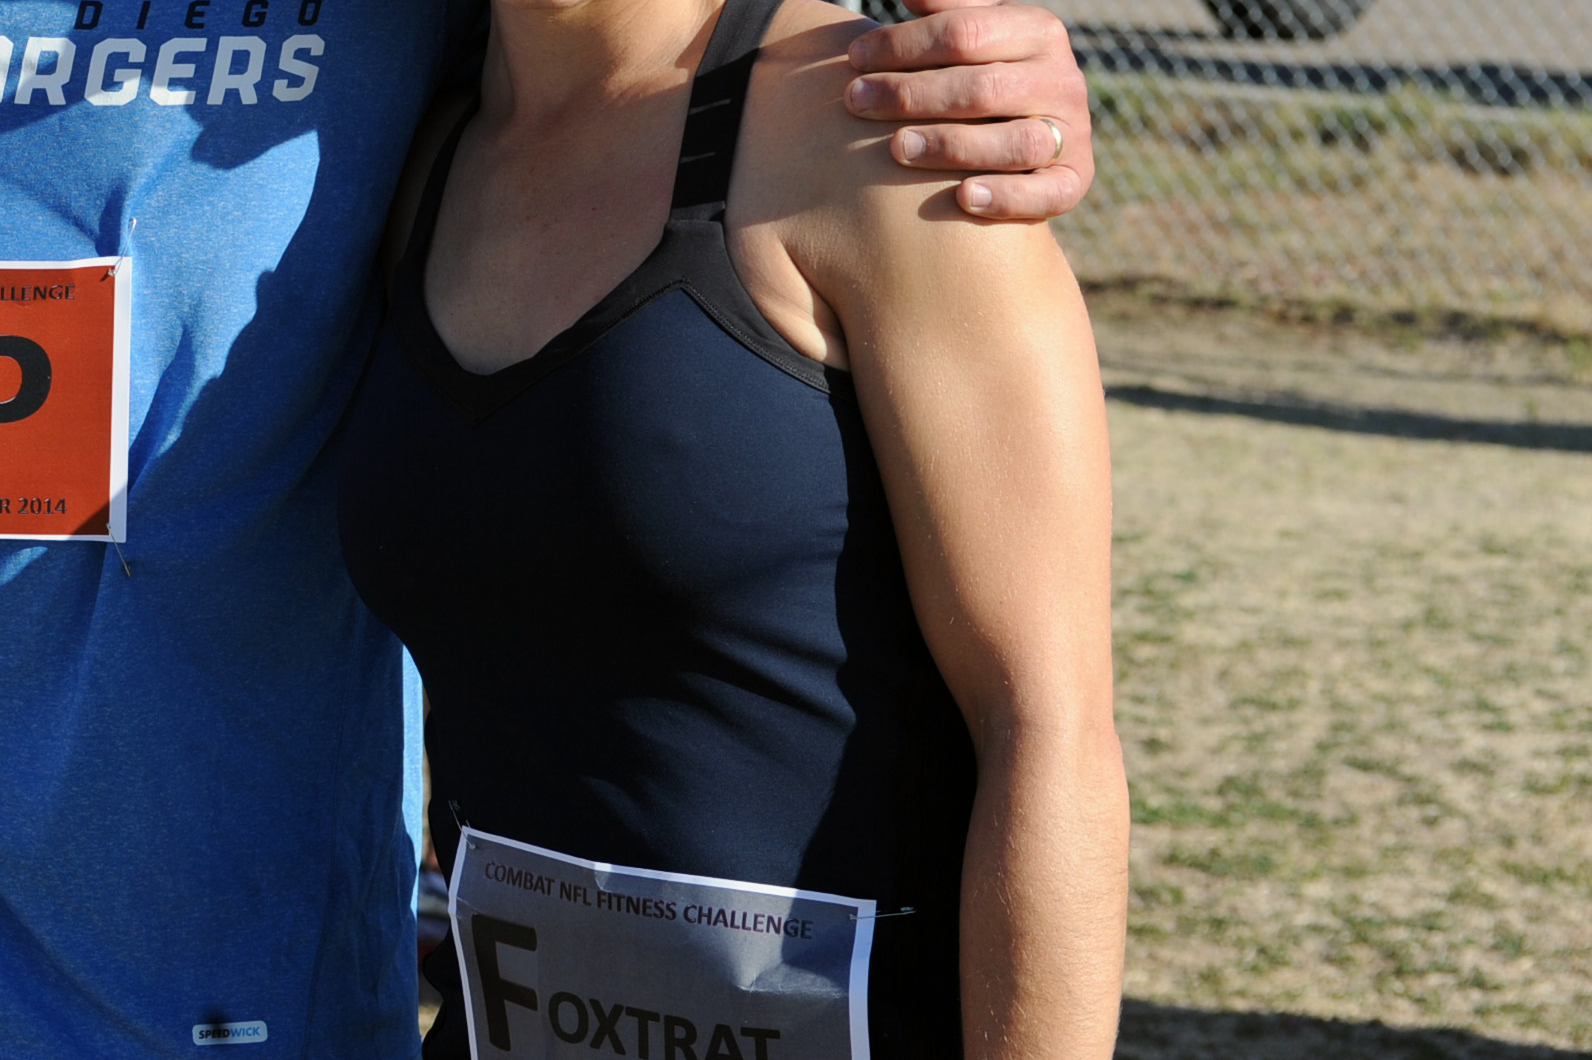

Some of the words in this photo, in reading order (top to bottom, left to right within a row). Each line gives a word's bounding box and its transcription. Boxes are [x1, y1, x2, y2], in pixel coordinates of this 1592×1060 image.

[18, 497, 68, 515] 2014
[485, 861, 556, 897] COMBAT
[560, 881, 593, 907] NFL
[596, 890, 677, 921] FITNESS
[683, 903, 814, 940] CHALLENGE
[198, 1026, 261, 1040] SPEEDWICK
